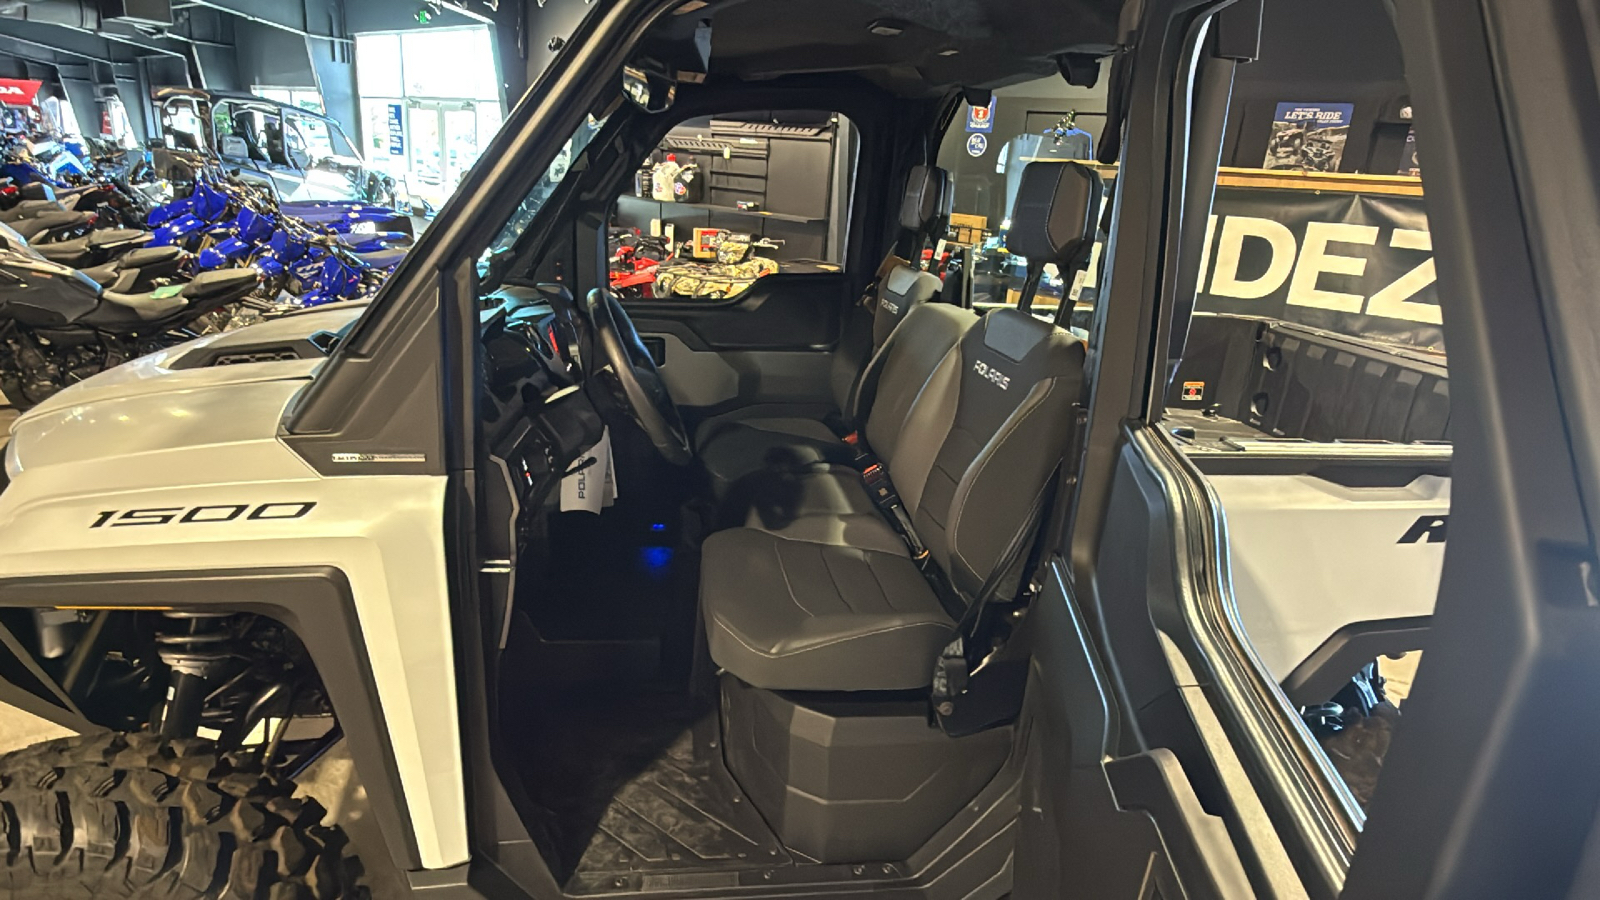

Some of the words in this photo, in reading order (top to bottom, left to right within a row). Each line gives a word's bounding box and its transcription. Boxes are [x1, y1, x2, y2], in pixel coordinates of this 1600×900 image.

[1284, 111, 1313, 120] LET'S
[1315, 111, 1342, 120] RIDE
[973, 359, 1011, 391] POLARIS
[89, 501, 318, 529] 1500
